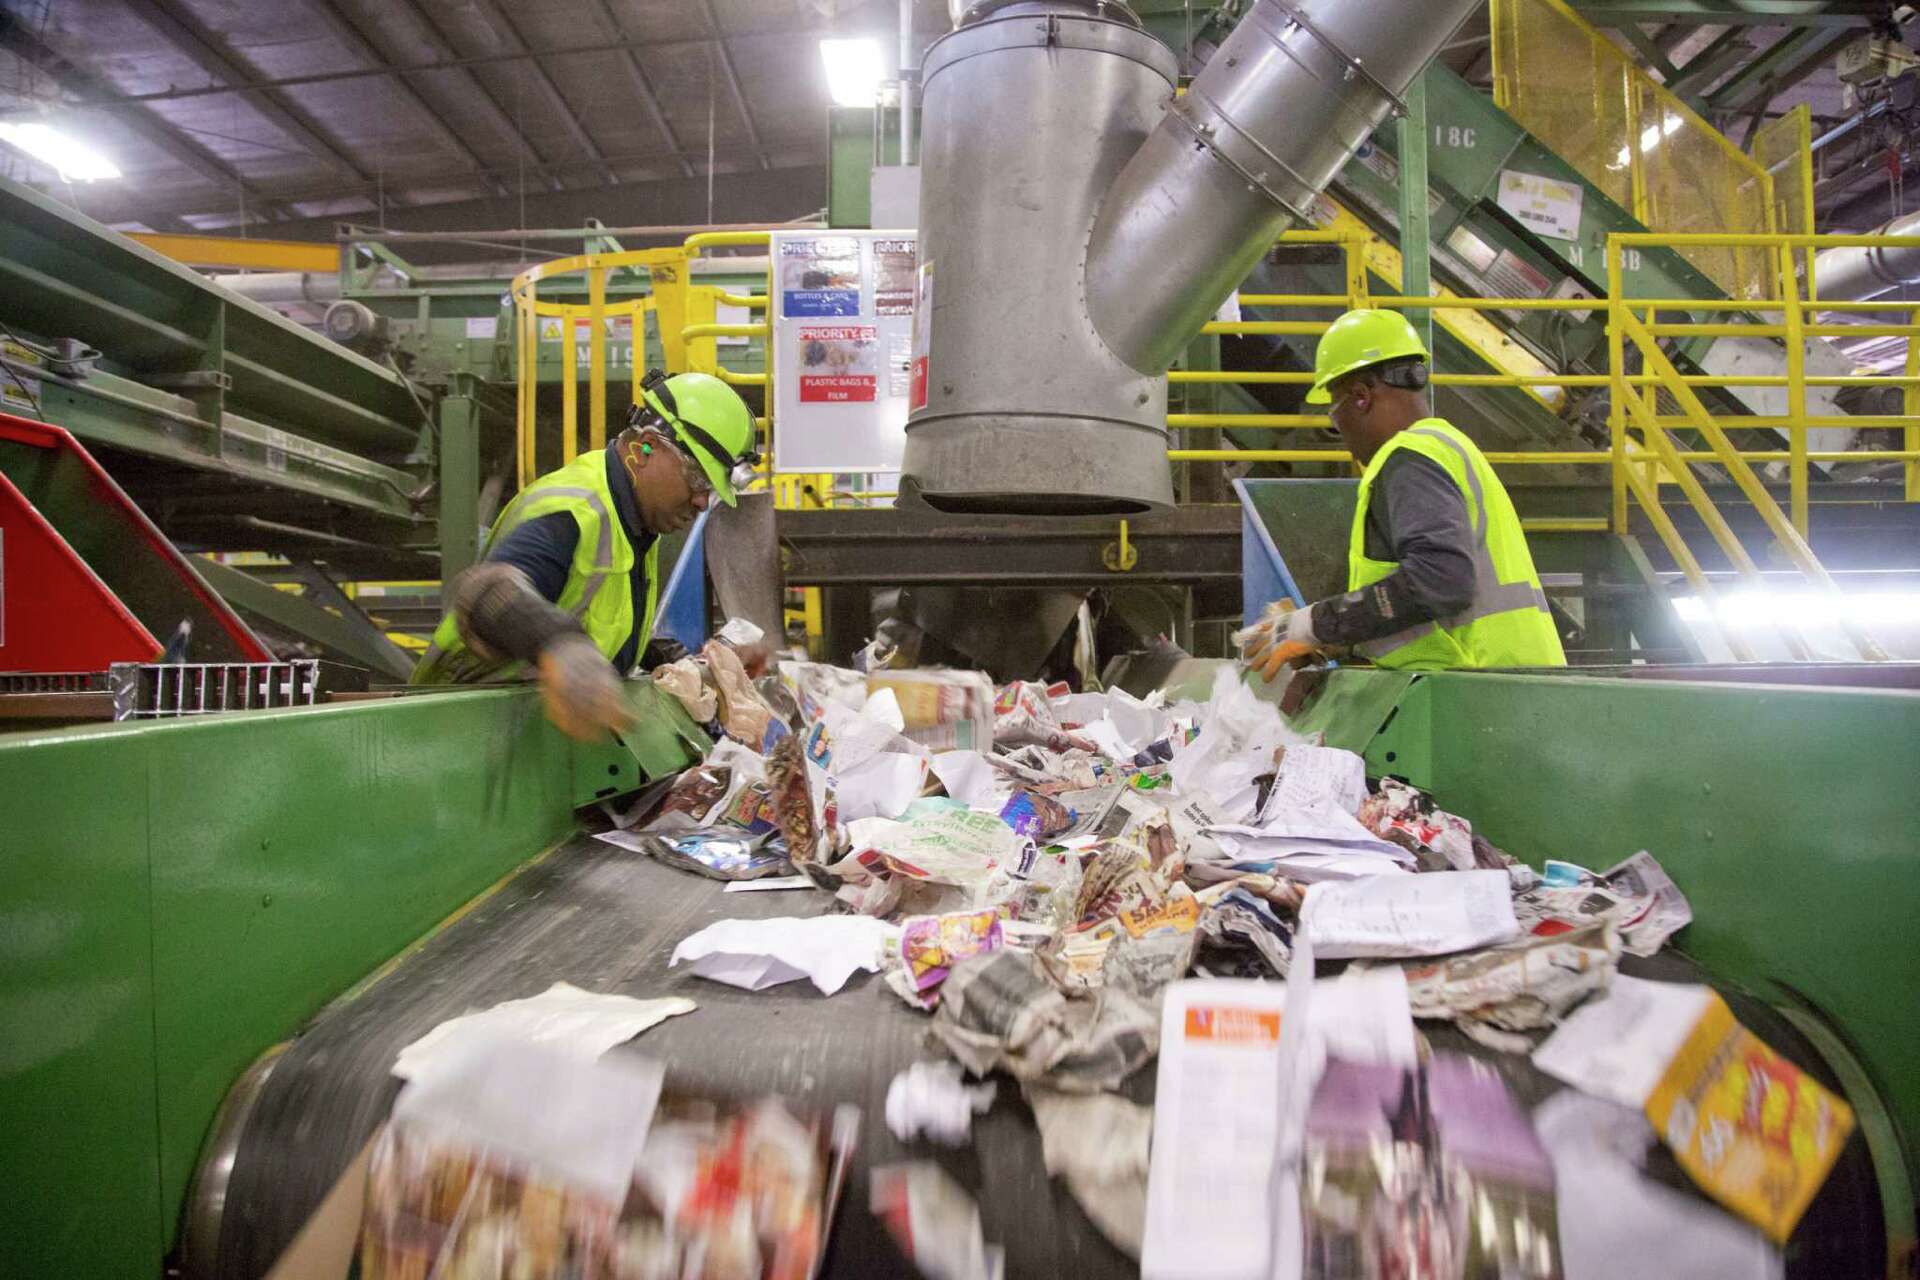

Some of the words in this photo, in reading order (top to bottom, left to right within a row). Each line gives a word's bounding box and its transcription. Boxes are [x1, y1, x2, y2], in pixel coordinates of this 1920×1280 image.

[875, 241, 914, 254] PRIOR
[805, 378, 838, 386] PLASTIC
[840, 378, 862, 386] BAGS
[827, 392, 848, 400] FILM
